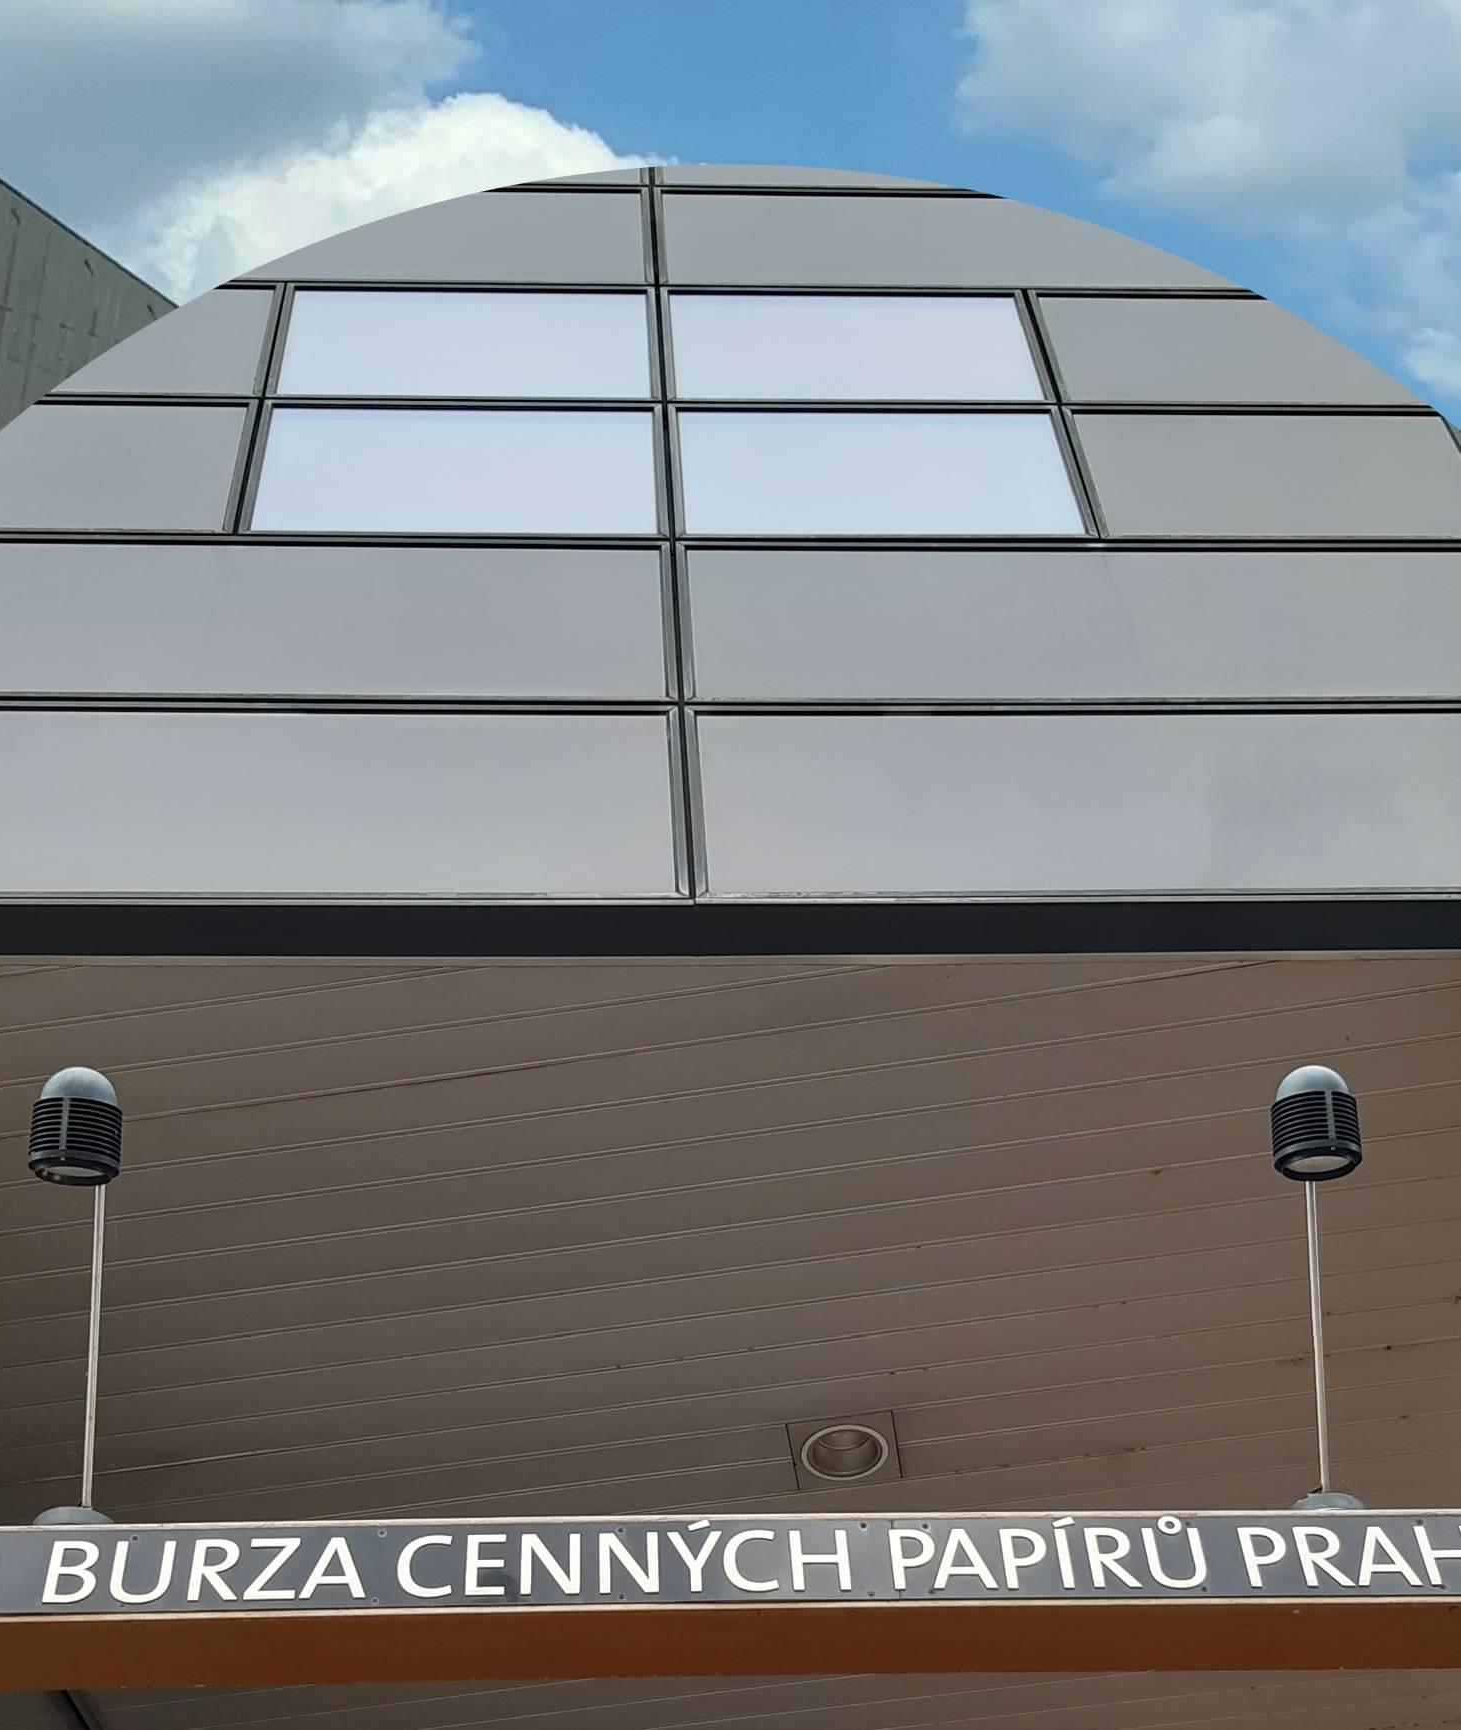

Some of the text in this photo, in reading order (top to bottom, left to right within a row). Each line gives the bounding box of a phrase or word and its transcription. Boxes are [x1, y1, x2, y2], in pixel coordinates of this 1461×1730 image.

[41, 1515, 1461, 1604] BURZA CENNÝCH PAPÍRŮ PRAH
